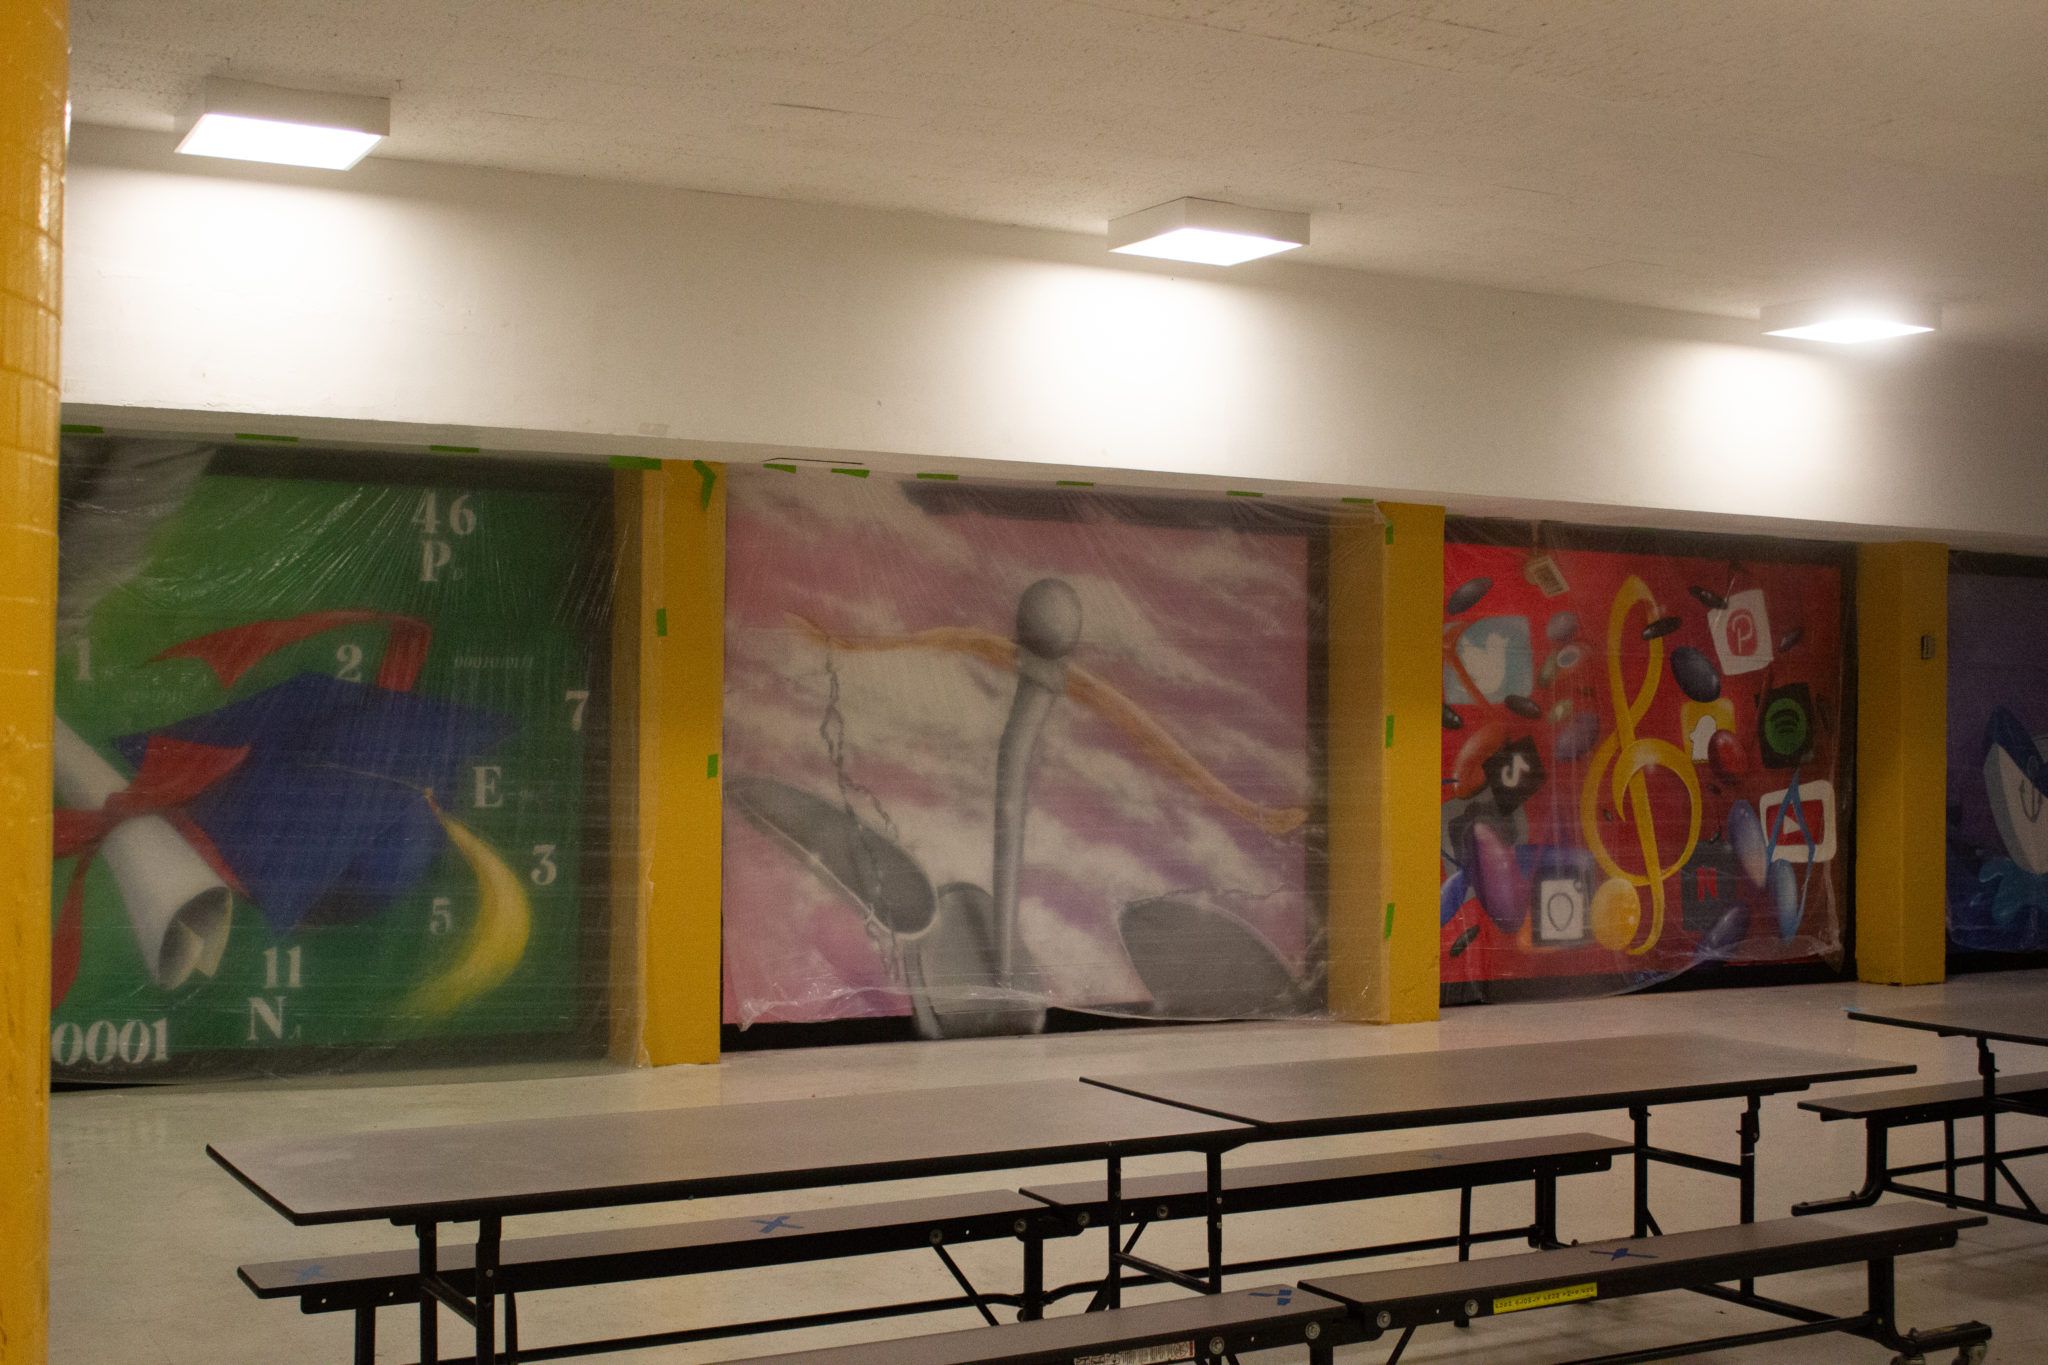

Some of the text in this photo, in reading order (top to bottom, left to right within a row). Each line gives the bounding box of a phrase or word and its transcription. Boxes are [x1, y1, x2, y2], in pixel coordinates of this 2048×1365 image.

[419, 539, 452, 582] P
[336, 644, 362, 683] 2
[565, 690, 590, 732] 7
[473, 765, 503, 808] E
[531, 844, 557, 886] 3
[430, 897, 452, 936] 5
[247, 996, 286, 1041] N
